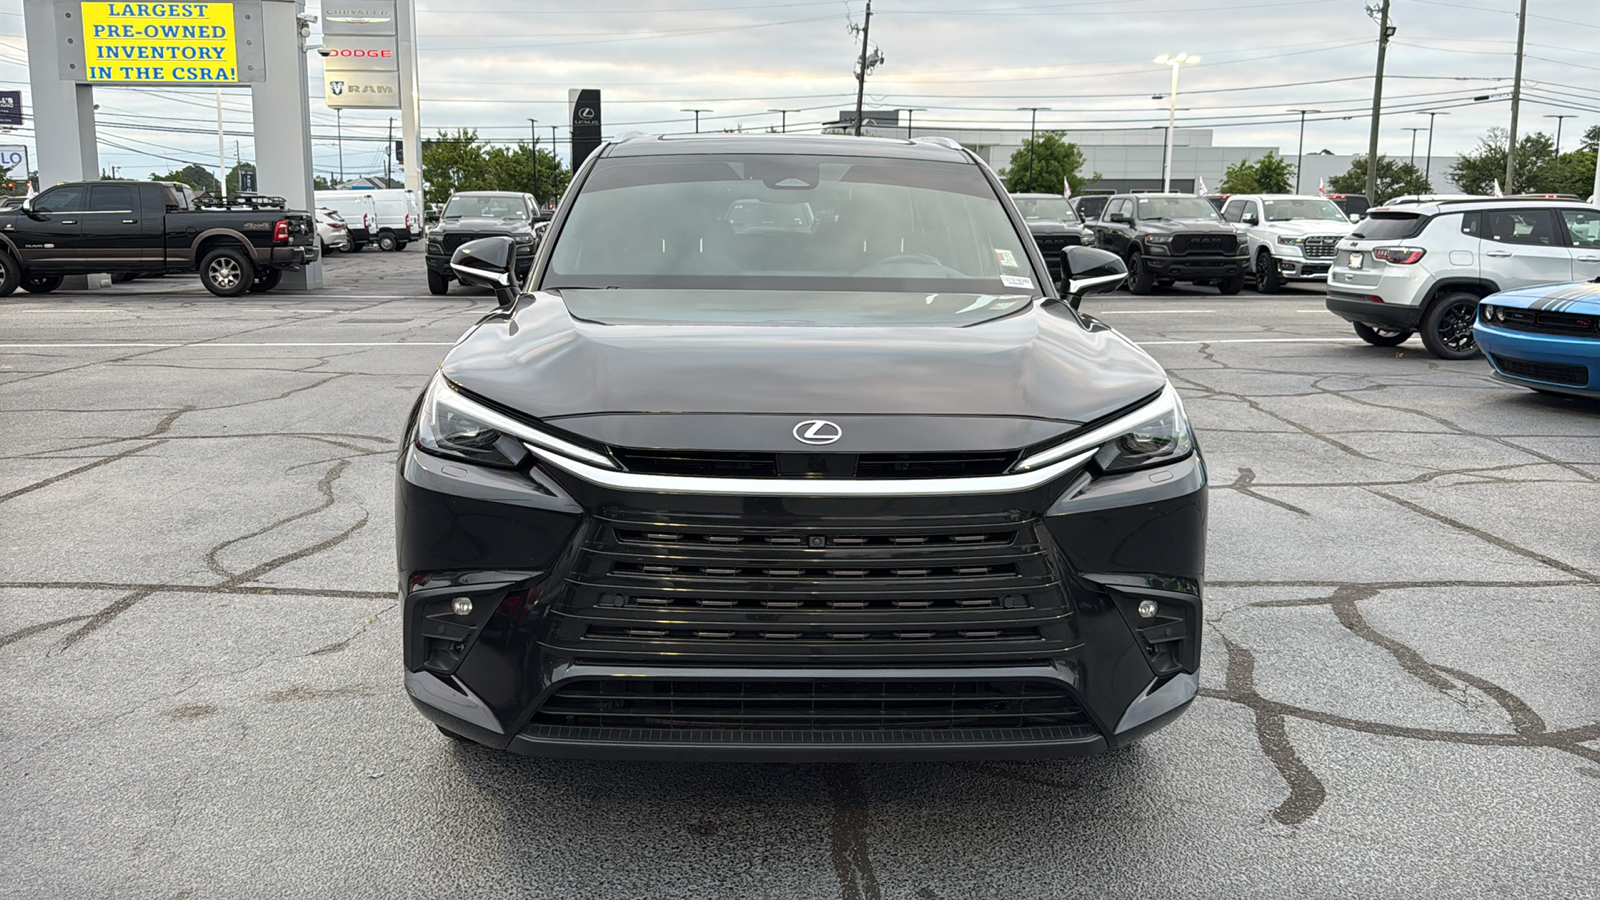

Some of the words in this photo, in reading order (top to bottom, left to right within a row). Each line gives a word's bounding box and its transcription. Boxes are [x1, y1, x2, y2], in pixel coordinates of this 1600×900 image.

[108, 4, 208, 17] LARGEST
[93, 24, 226, 38] PRE-OWNED
[96, 45, 226, 59] INVENTORY
[329, 49, 391, 57] DODGE
[89, 66, 112, 79] IN
[120, 67, 165, 80] THE
[172, 67, 236, 81] CSRA!
[347, 85, 394, 94] RAM
